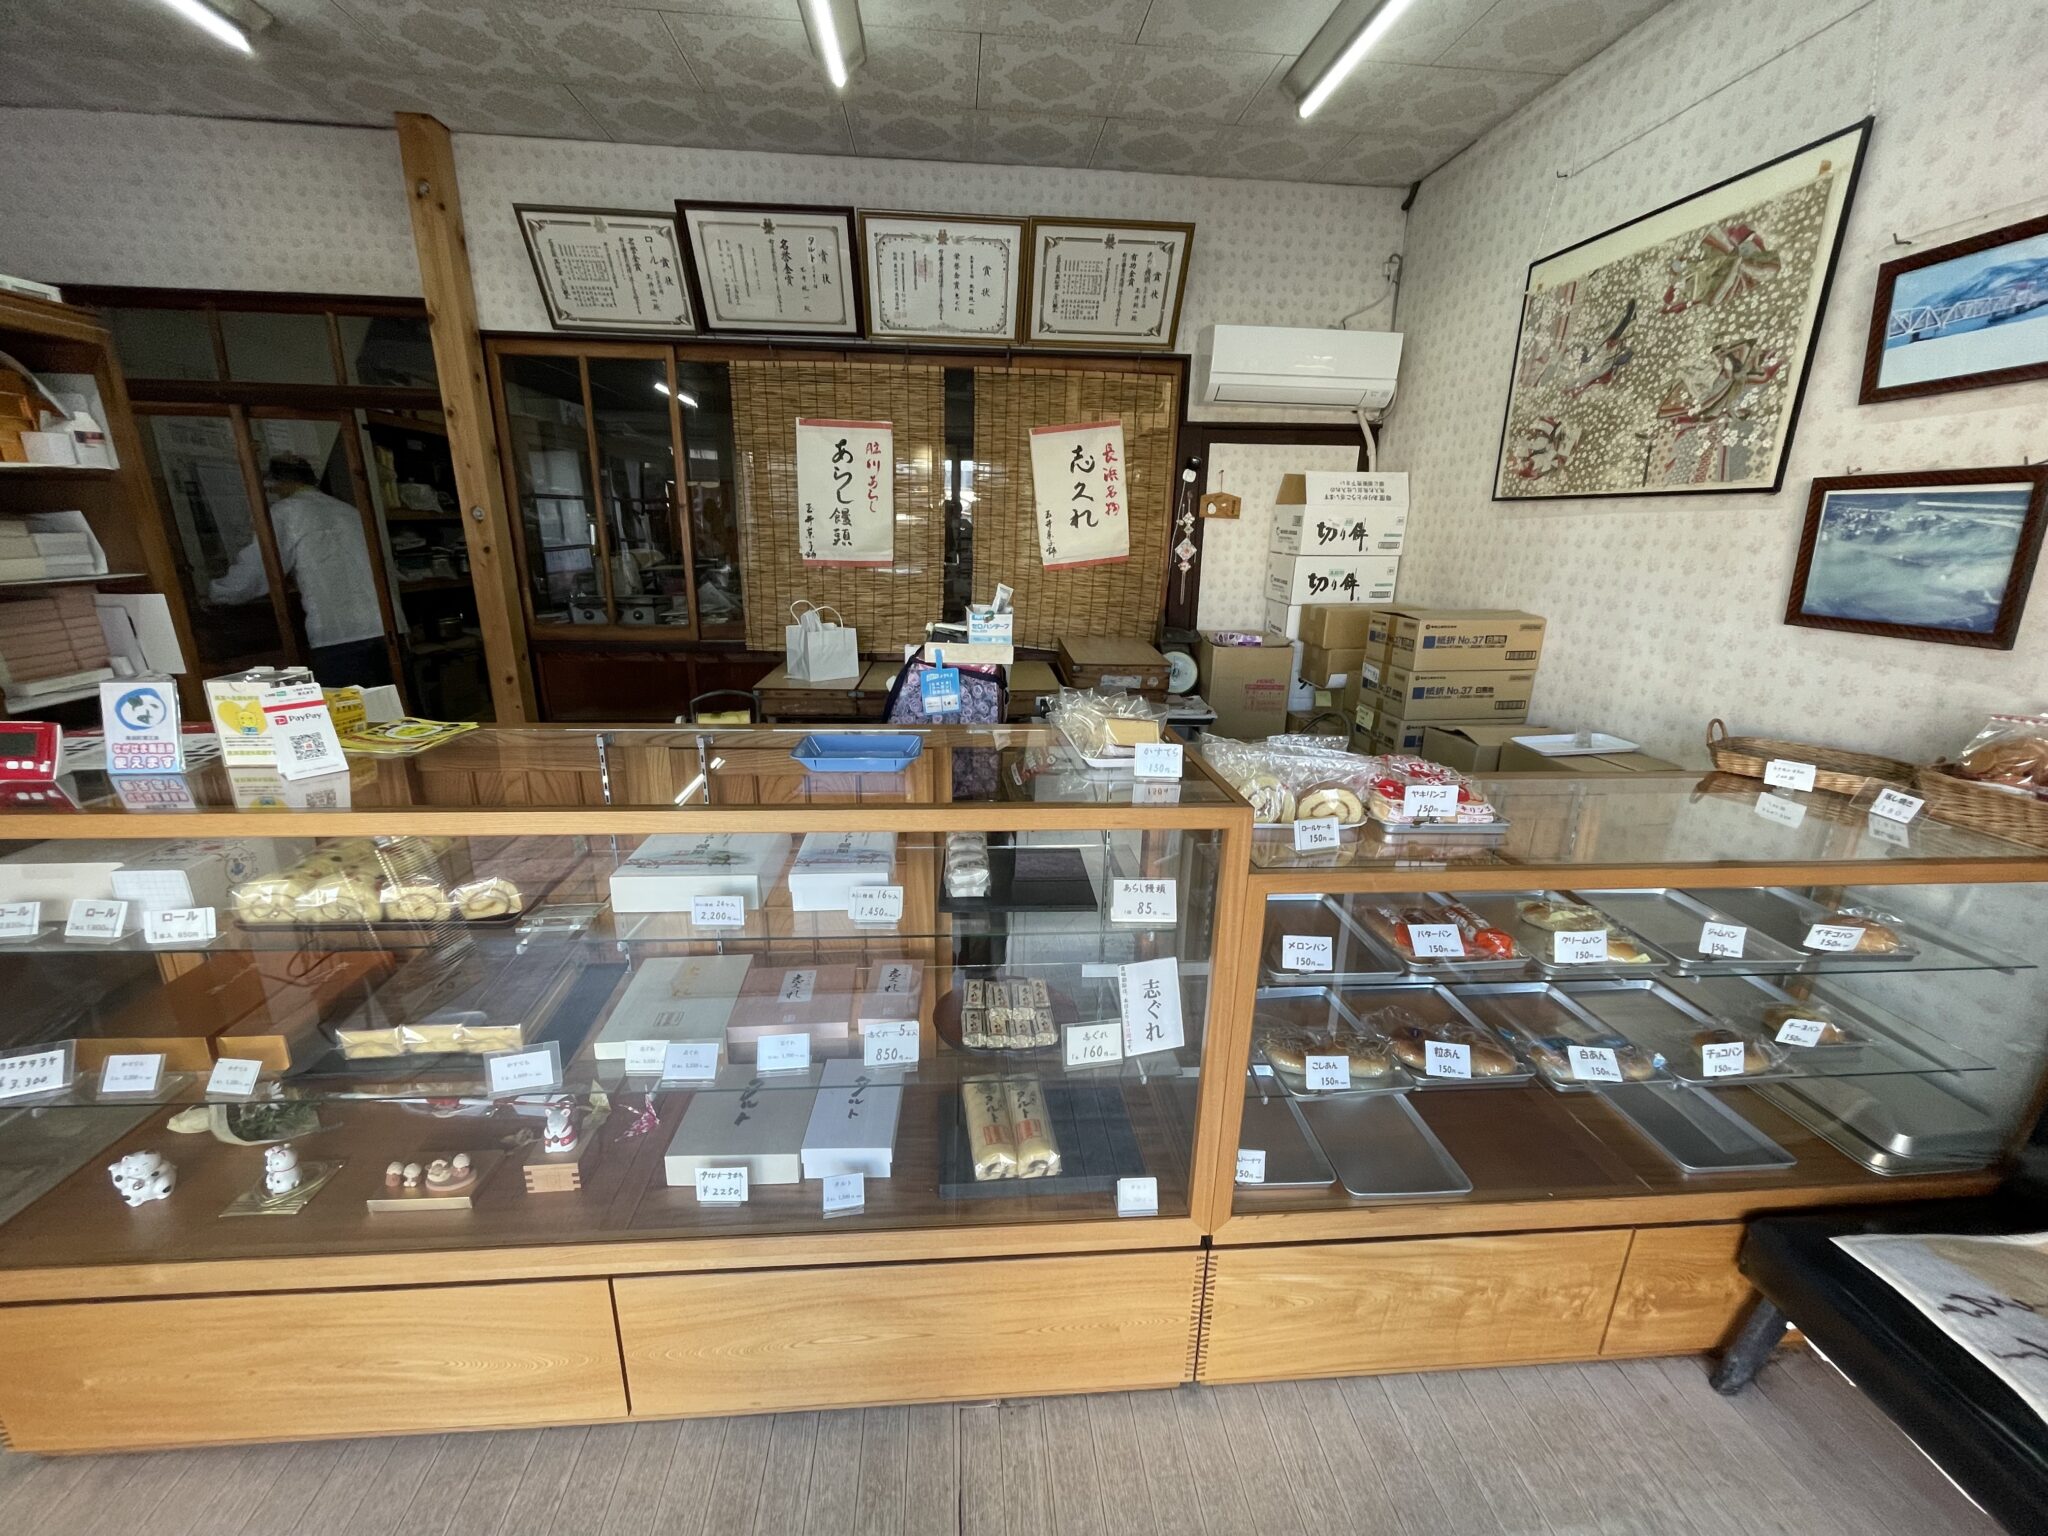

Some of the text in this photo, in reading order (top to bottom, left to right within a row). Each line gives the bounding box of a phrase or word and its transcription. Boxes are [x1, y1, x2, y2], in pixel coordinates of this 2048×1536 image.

[645, 236, 658, 264] ロール
[807, 236, 816, 263] タルト
[981, 265, 992, 297] 賞状
[829, 438, 855, 547] あらし饅頭
[1316, 518, 1369, 552] 切り餅
[1308, 569, 1360, 601] 切り餅
[1458, 636, 1484, 644] No.37
[1447, 686, 1473, 695] No.37
[288, 713, 321, 723] PayPay
[1412, 790, 1447, 799] ヤキリンゴ
[1301, 824, 1333, 832] ロールケーキ
[85, 908, 116, 918] ロール
[162, 911, 199, 921] ロール
[1417, 930, 1452, 938] バターパン
[1707, 928, 1738, 938] ジャムパン
[1561, 936, 1602, 945] クリームパン
[1288, 942, 1328, 952] メロンパン
[1142, 979, 1164, 1042] 志ぐれ
[1433, 1046, 1460, 1059] 粒あん
[1580, 1049, 1607, 1061] 白あん
[1706, 1049, 1742, 1059] チョコパン
[1312, 1061, 1338, 1070] こしあん
[848, 1075, 870, 1119] タルト
[985, 1095, 1000, 1123] タルト
[1017, 1090, 1030, 1119] タルト
